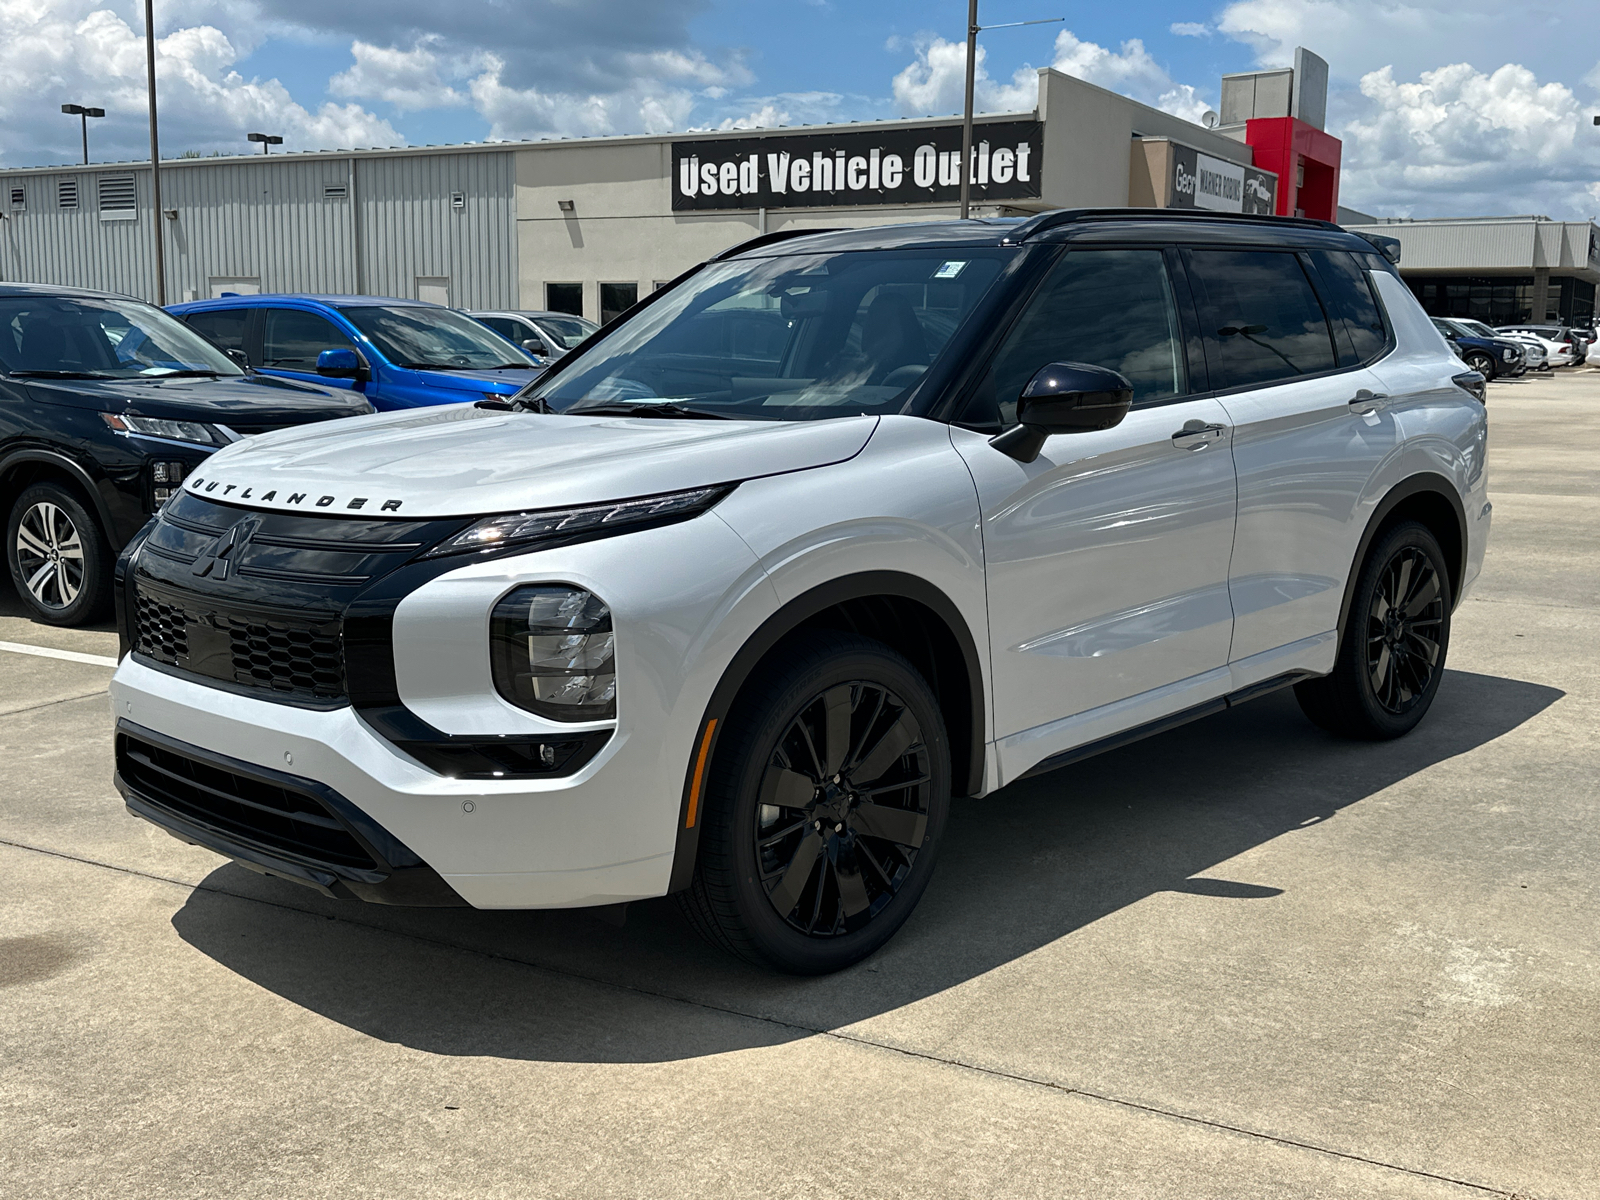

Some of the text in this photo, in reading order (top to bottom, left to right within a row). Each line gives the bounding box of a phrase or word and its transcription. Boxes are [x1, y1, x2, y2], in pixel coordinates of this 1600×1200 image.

[680, 154, 759, 197] Used
[767, 148, 903, 193] Vehicle
[1200, 168, 1241, 202] WARNER ROBINS
[191, 478, 403, 512] OUTLANDER
[788, 668, 822, 700] TIRES
